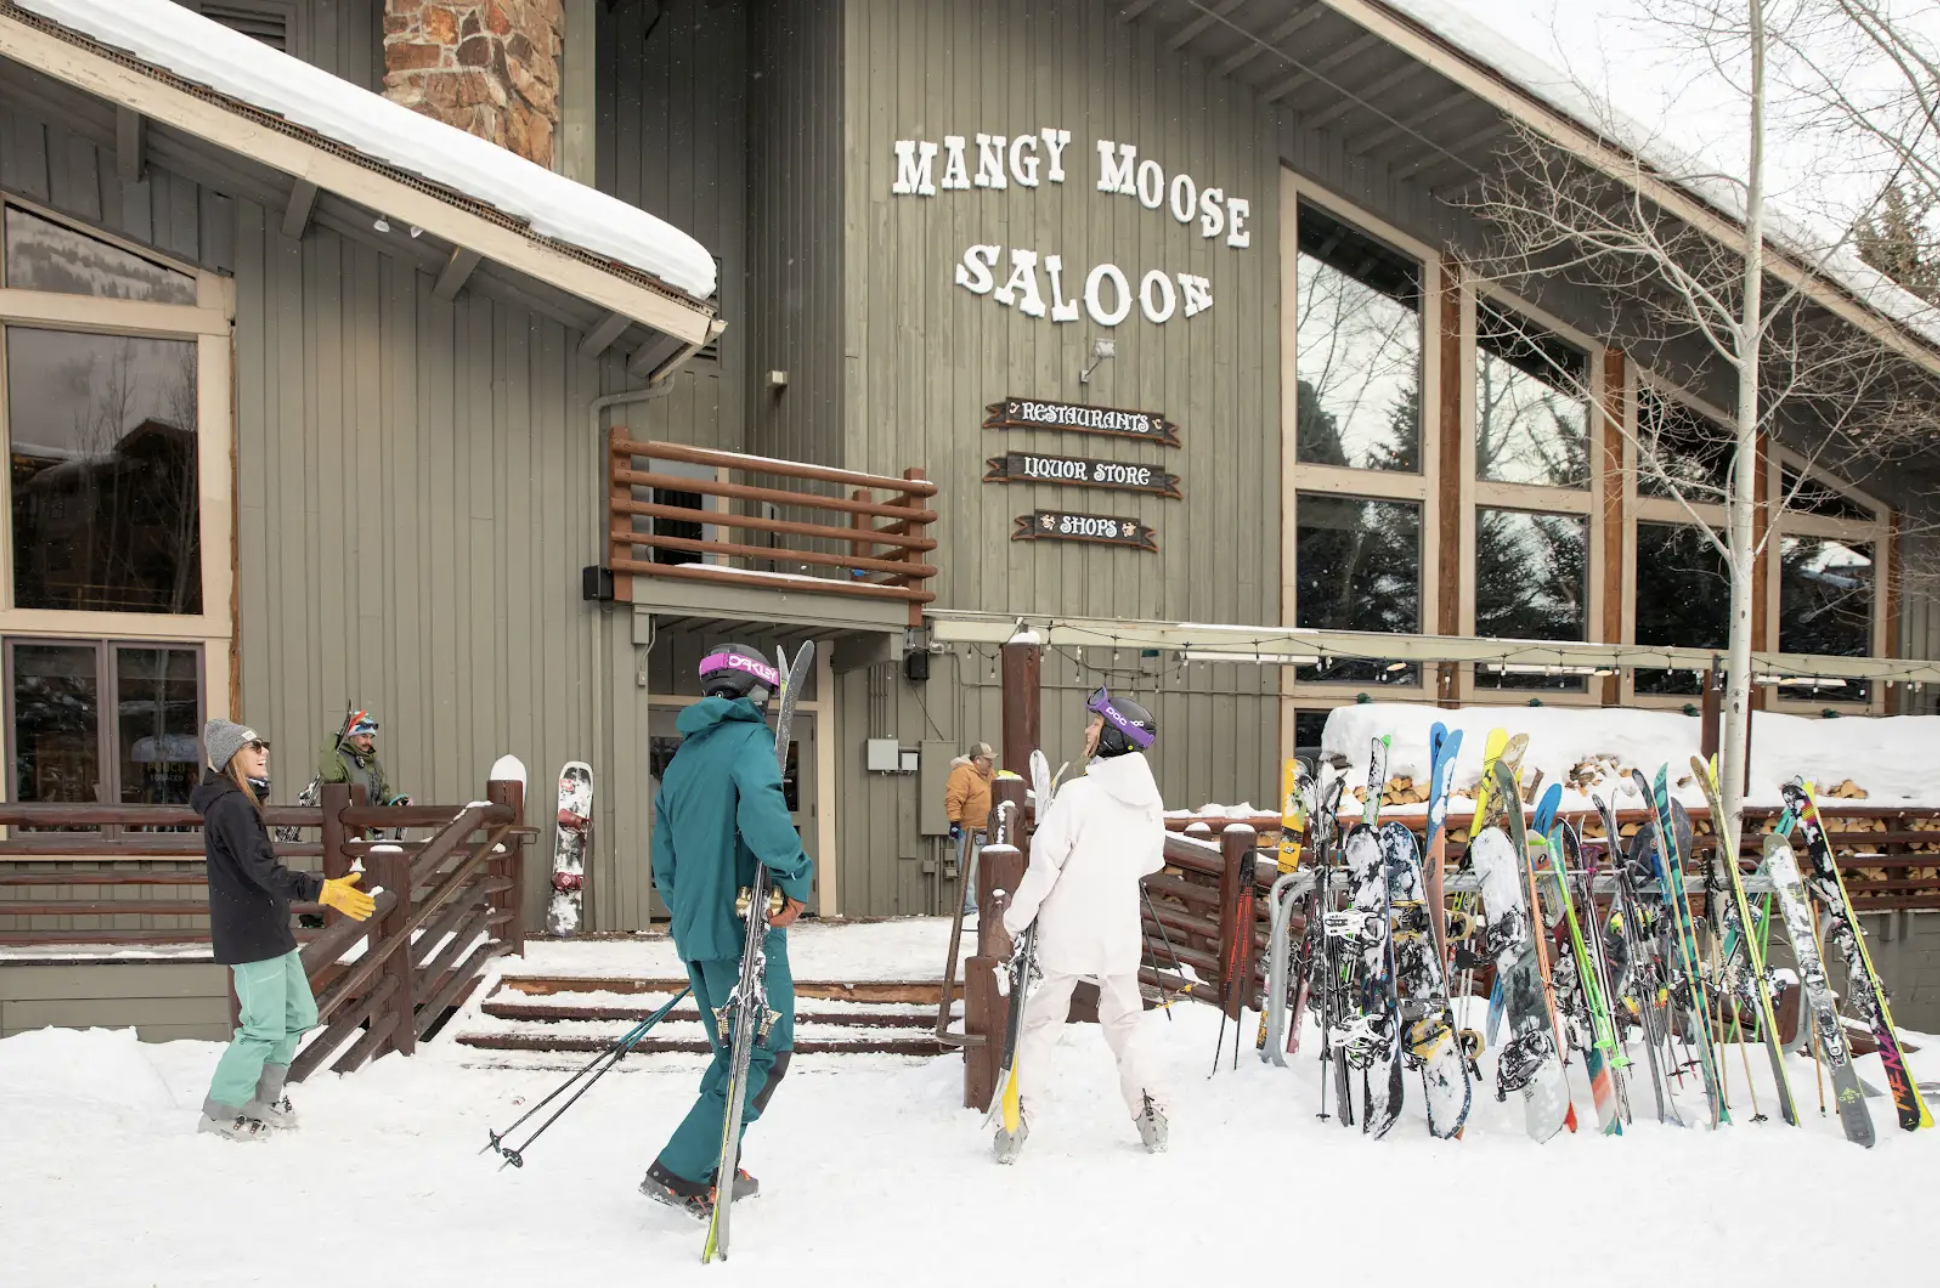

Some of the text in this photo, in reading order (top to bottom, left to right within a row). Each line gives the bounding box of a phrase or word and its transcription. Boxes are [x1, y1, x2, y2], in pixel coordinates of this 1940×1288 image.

[892, 127, 1250, 248] MANGY MOOSE
[955, 244, 1214, 326] SALOON
[1021, 401, 1149, 433] RESTAURANTS
[1024, 456, 1151, 485] LIQUOR STORE
[1060, 515, 1117, 538] SHOPS
[728, 655, 778, 680] OAKLEY
